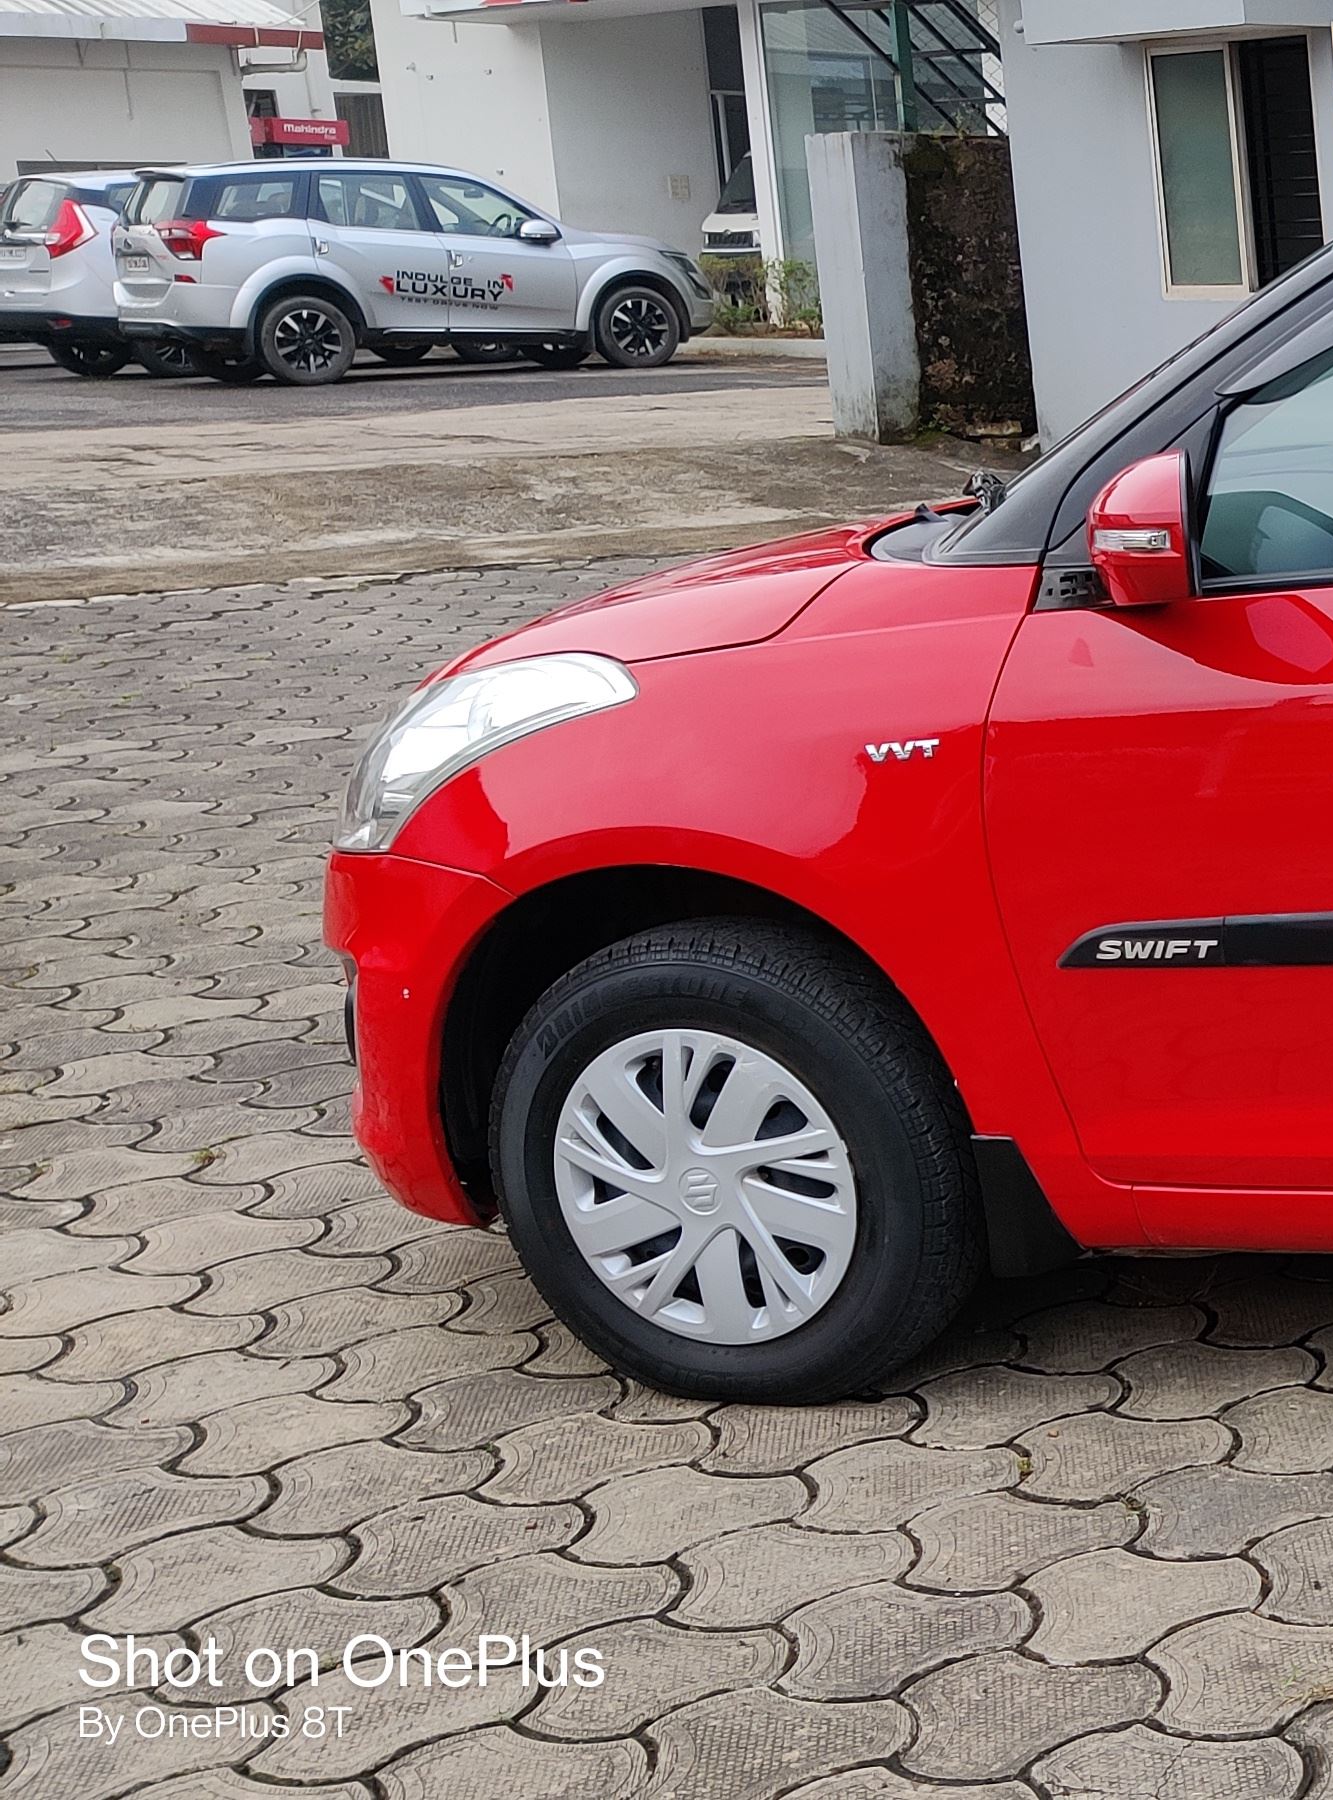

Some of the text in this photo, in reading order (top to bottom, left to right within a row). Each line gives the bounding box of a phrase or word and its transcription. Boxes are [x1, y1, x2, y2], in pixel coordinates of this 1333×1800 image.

[396, 270, 505, 290] INDULGE IN
[396, 281, 503, 302] LUXURY
[864, 738, 940, 762] VVT
[1096, 940, 1218, 960] SWIFT
